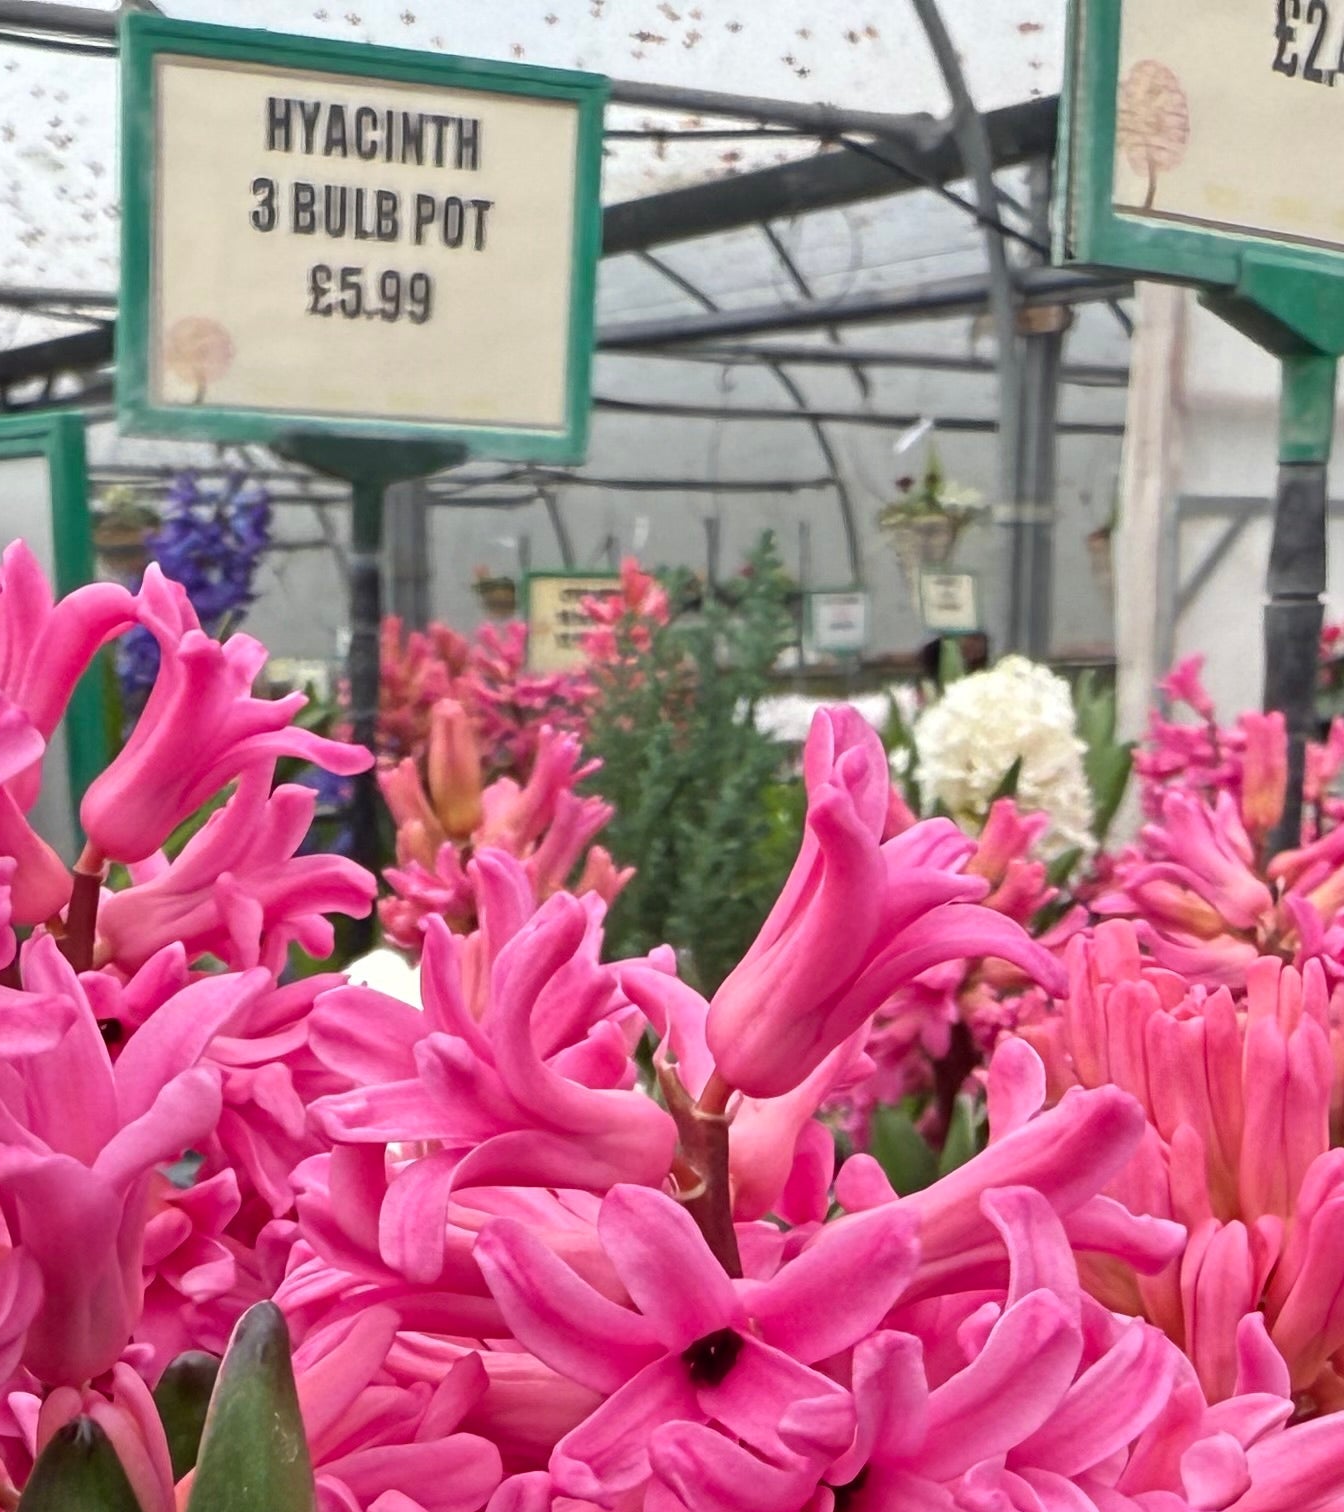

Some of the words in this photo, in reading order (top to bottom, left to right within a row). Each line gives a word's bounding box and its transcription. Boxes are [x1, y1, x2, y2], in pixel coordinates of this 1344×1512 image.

[267, 97, 481, 171] HYACINTH
[250, 178, 277, 233] 3
[293, 182, 399, 243] BULB
[415, 194, 494, 251] POT
[308, 264, 433, 323] £5.99
